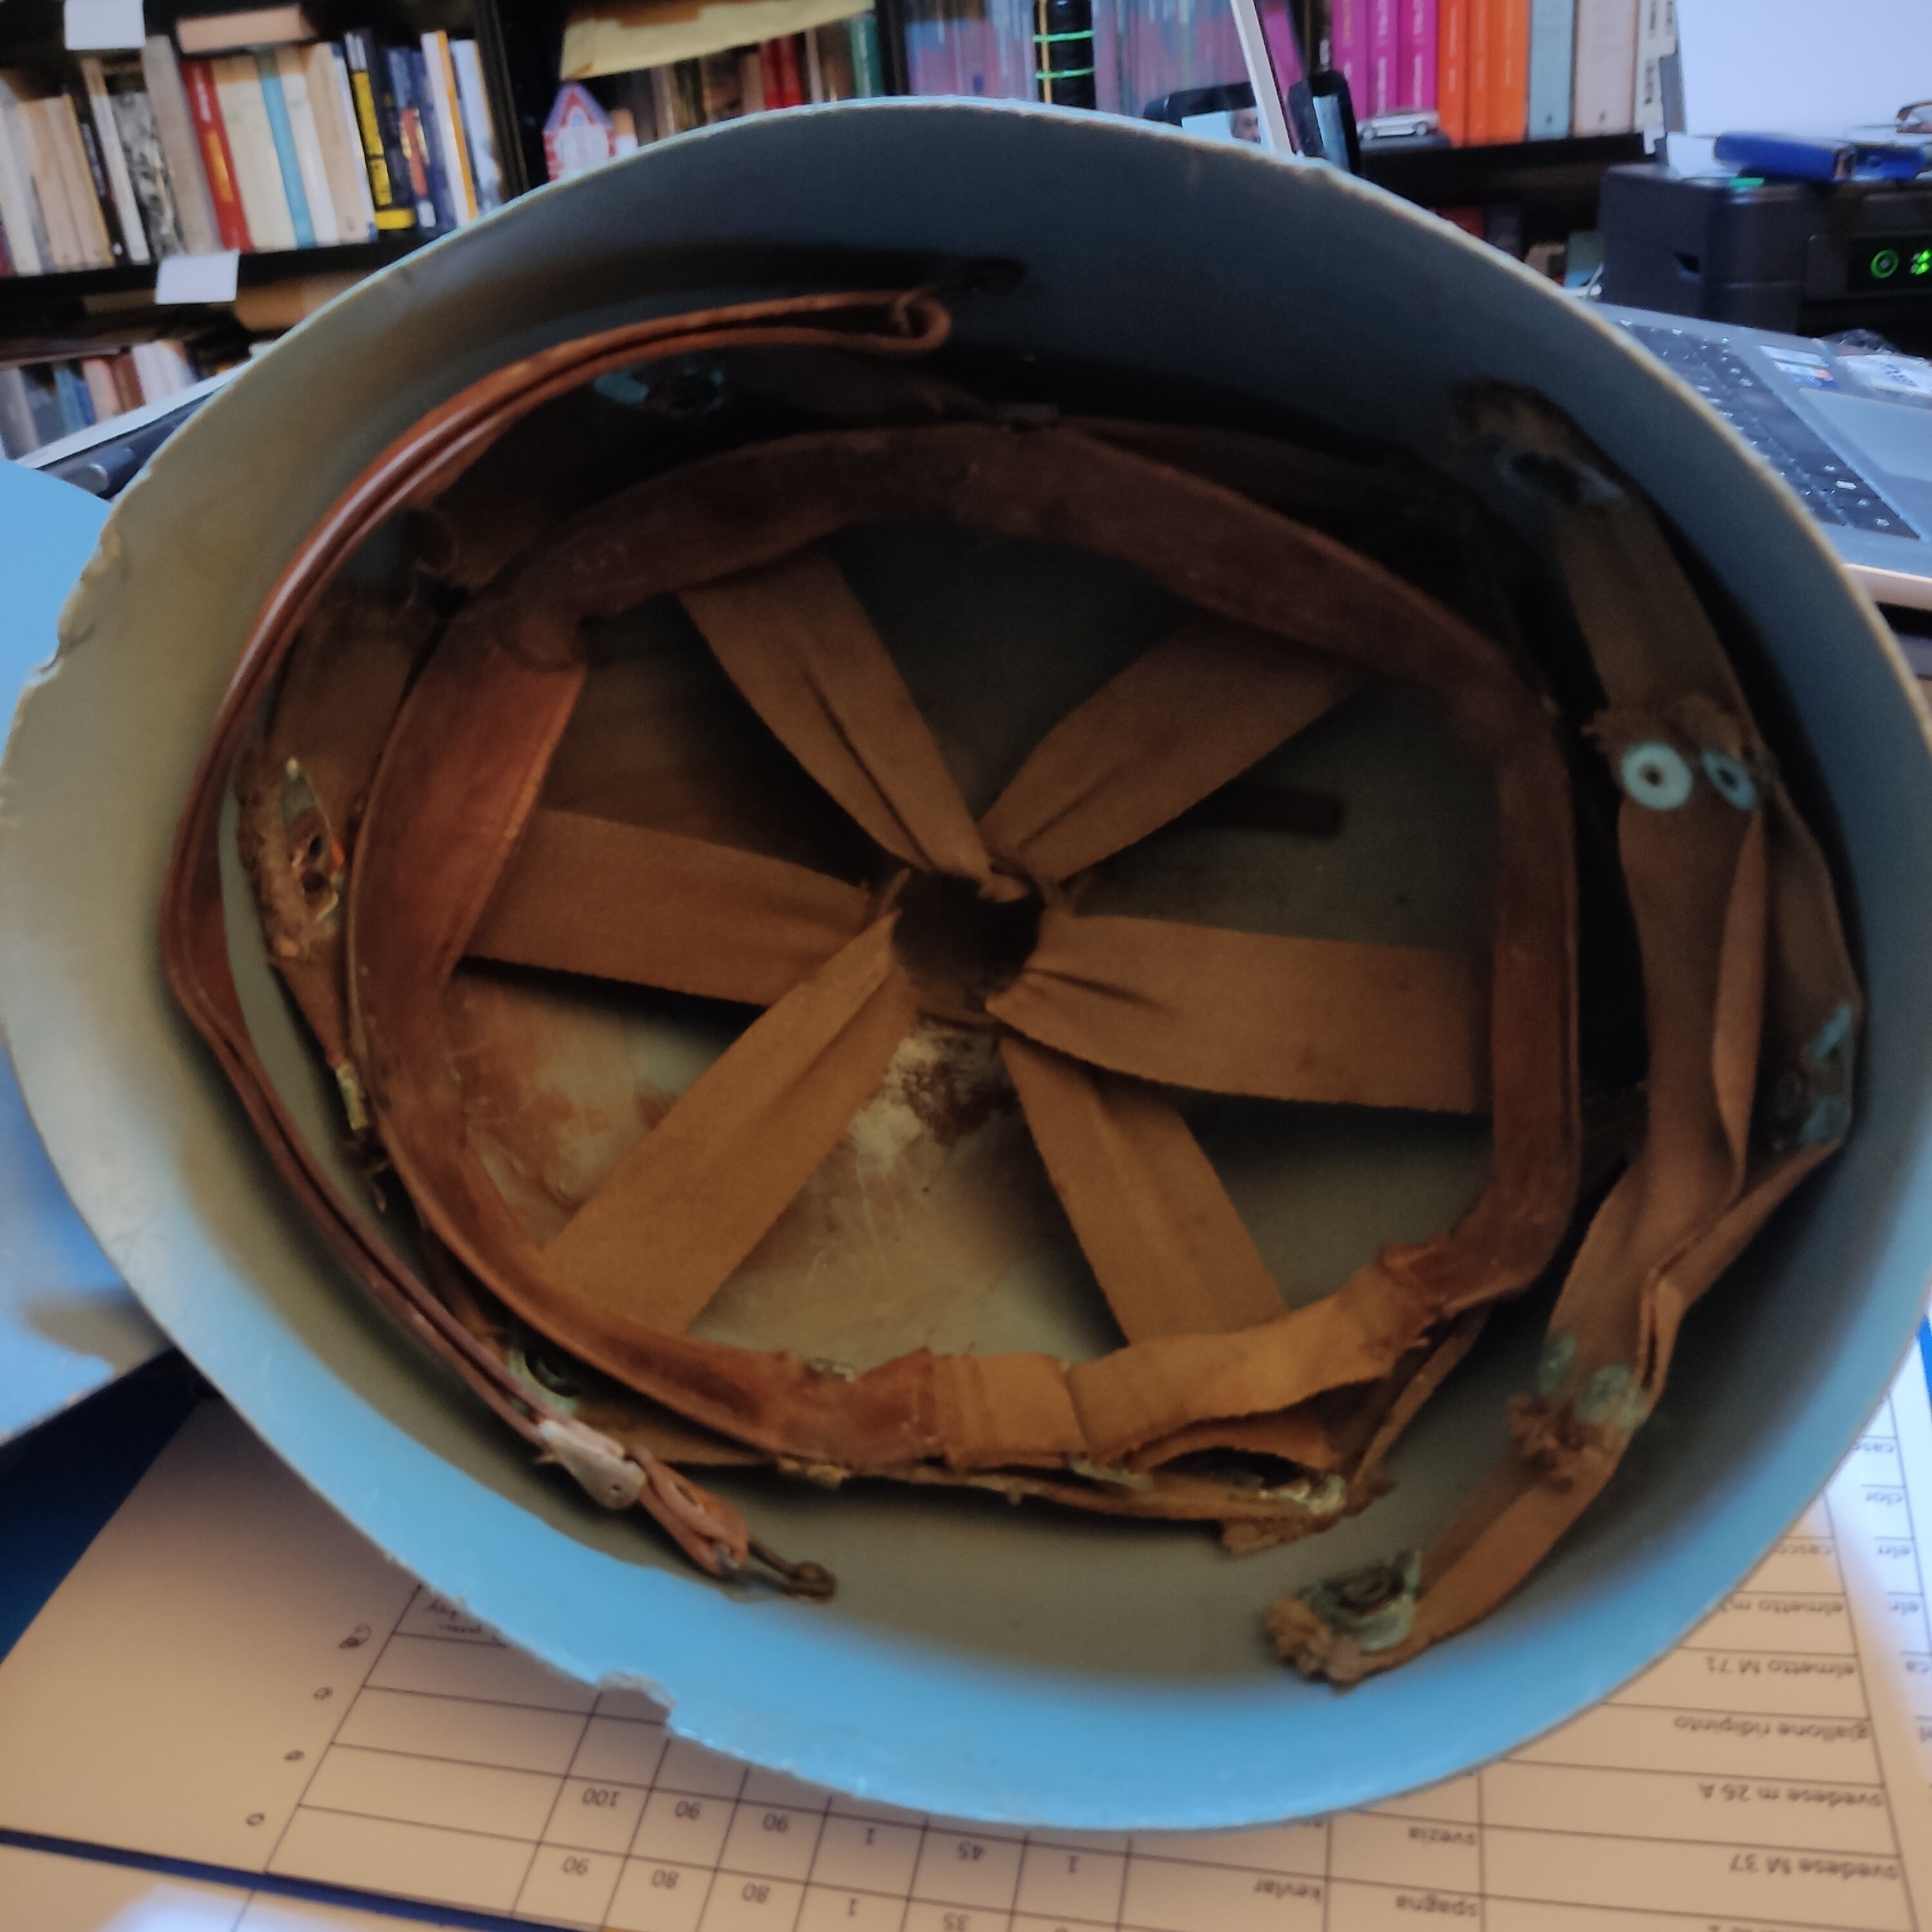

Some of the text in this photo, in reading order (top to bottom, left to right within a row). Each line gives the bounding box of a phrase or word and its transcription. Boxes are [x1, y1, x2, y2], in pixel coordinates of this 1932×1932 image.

[1757, 1599, 1843, 1616] elmetto
[1705, 1656, 1855, 1678] elmetto M 71
[1673, 1716, 1868, 1741] giallone ridipinto
[582, 1787, 621, 1808] 100
[1698, 1783, 1716, 1801] A
[1757, 1787, 1781, 1801] m
[1786, 1788, 1883, 1808] svedese
[675, 1801, 701, 1821] 90
[762, 1813, 789, 1833] 90
[1408, 1826, 1477, 1846] svezia
[958, 1842, 985, 1861] 45
[562, 1855, 589, 1875] 90
[1766, 1857, 1792, 1875] M
[1798, 1858, 1898, 1881] svedese
[651, 1869, 679, 1889] 80
[742, 1883, 770, 1904] 80
[1253, 1880, 1321, 1903] kevlar
[1395, 1895, 1479, 1918] spagna
